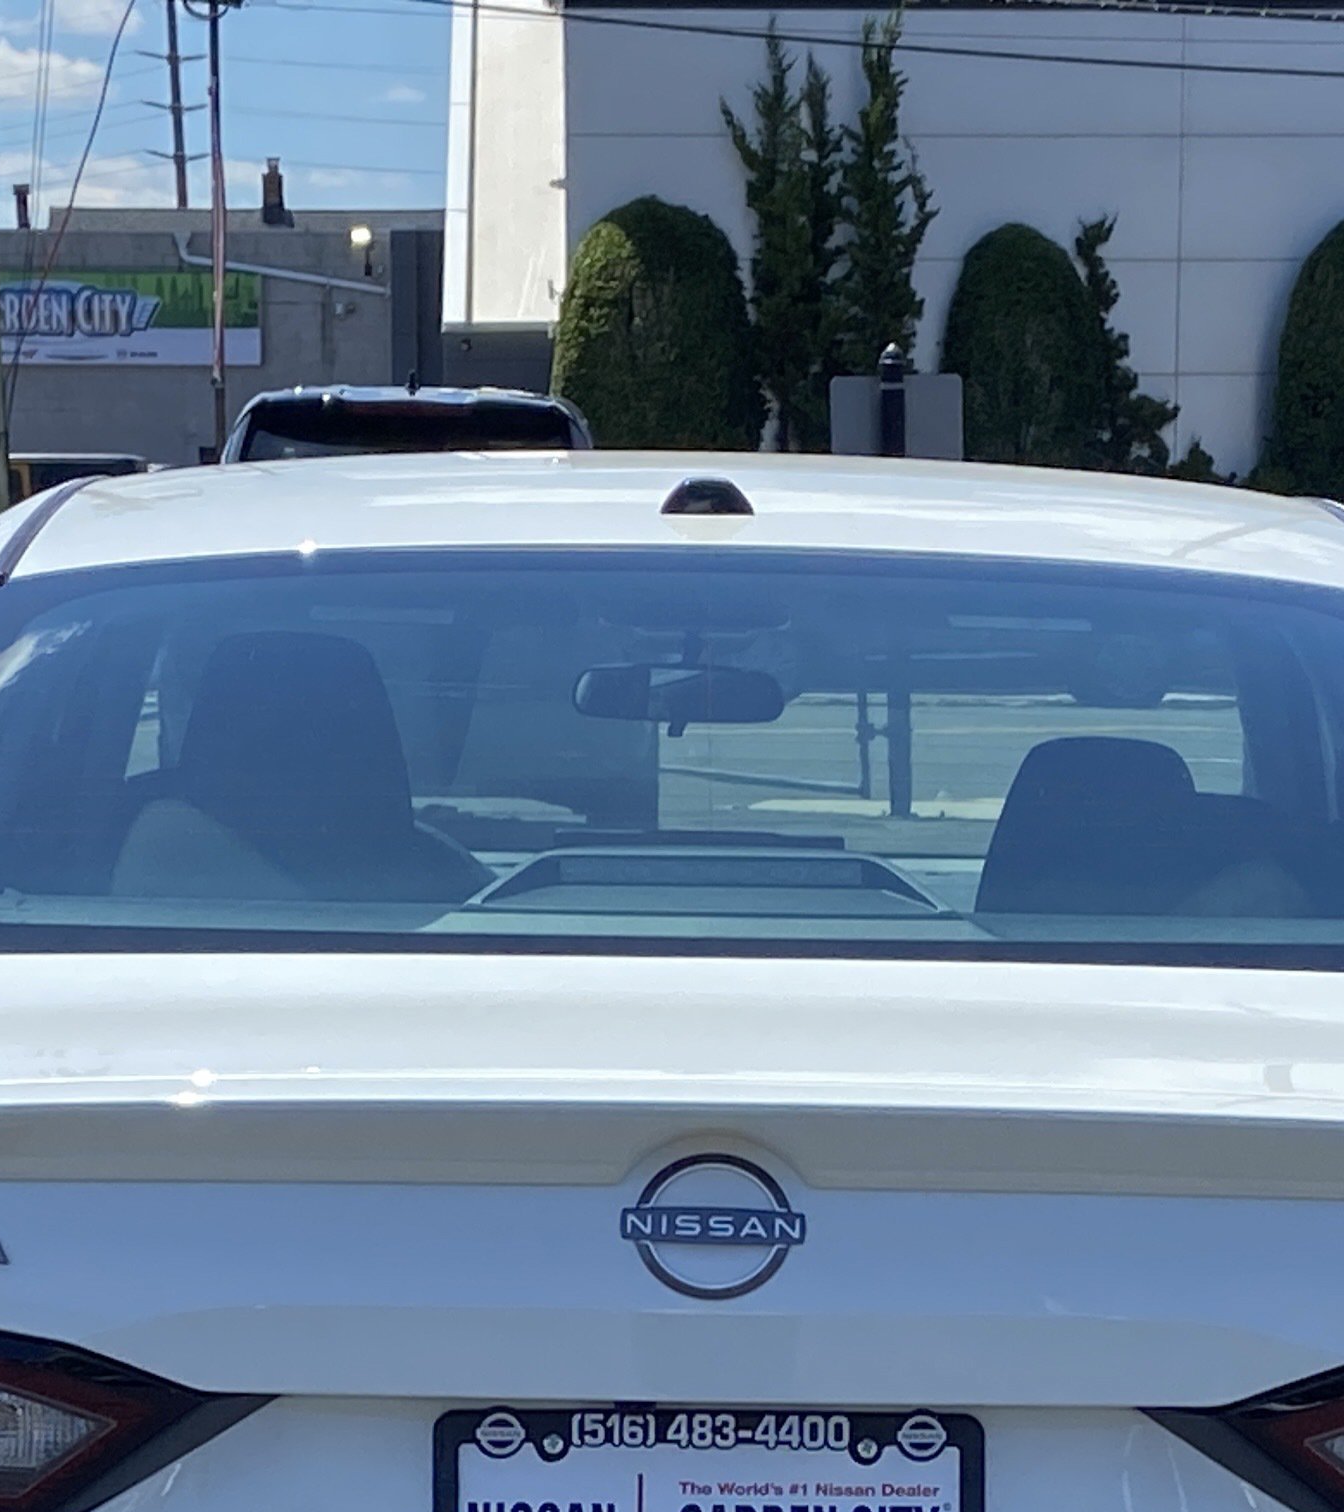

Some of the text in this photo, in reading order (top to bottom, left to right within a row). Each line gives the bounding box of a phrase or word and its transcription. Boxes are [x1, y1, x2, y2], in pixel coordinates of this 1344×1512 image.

[0, 289, 133, 333] RDEN CITY
[626, 1213, 801, 1240] NISSAN
[571, 1413, 851, 1450] (516) 483-4400
[679, 1481, 940, 1497] The World's #1 Nissan Dealer
